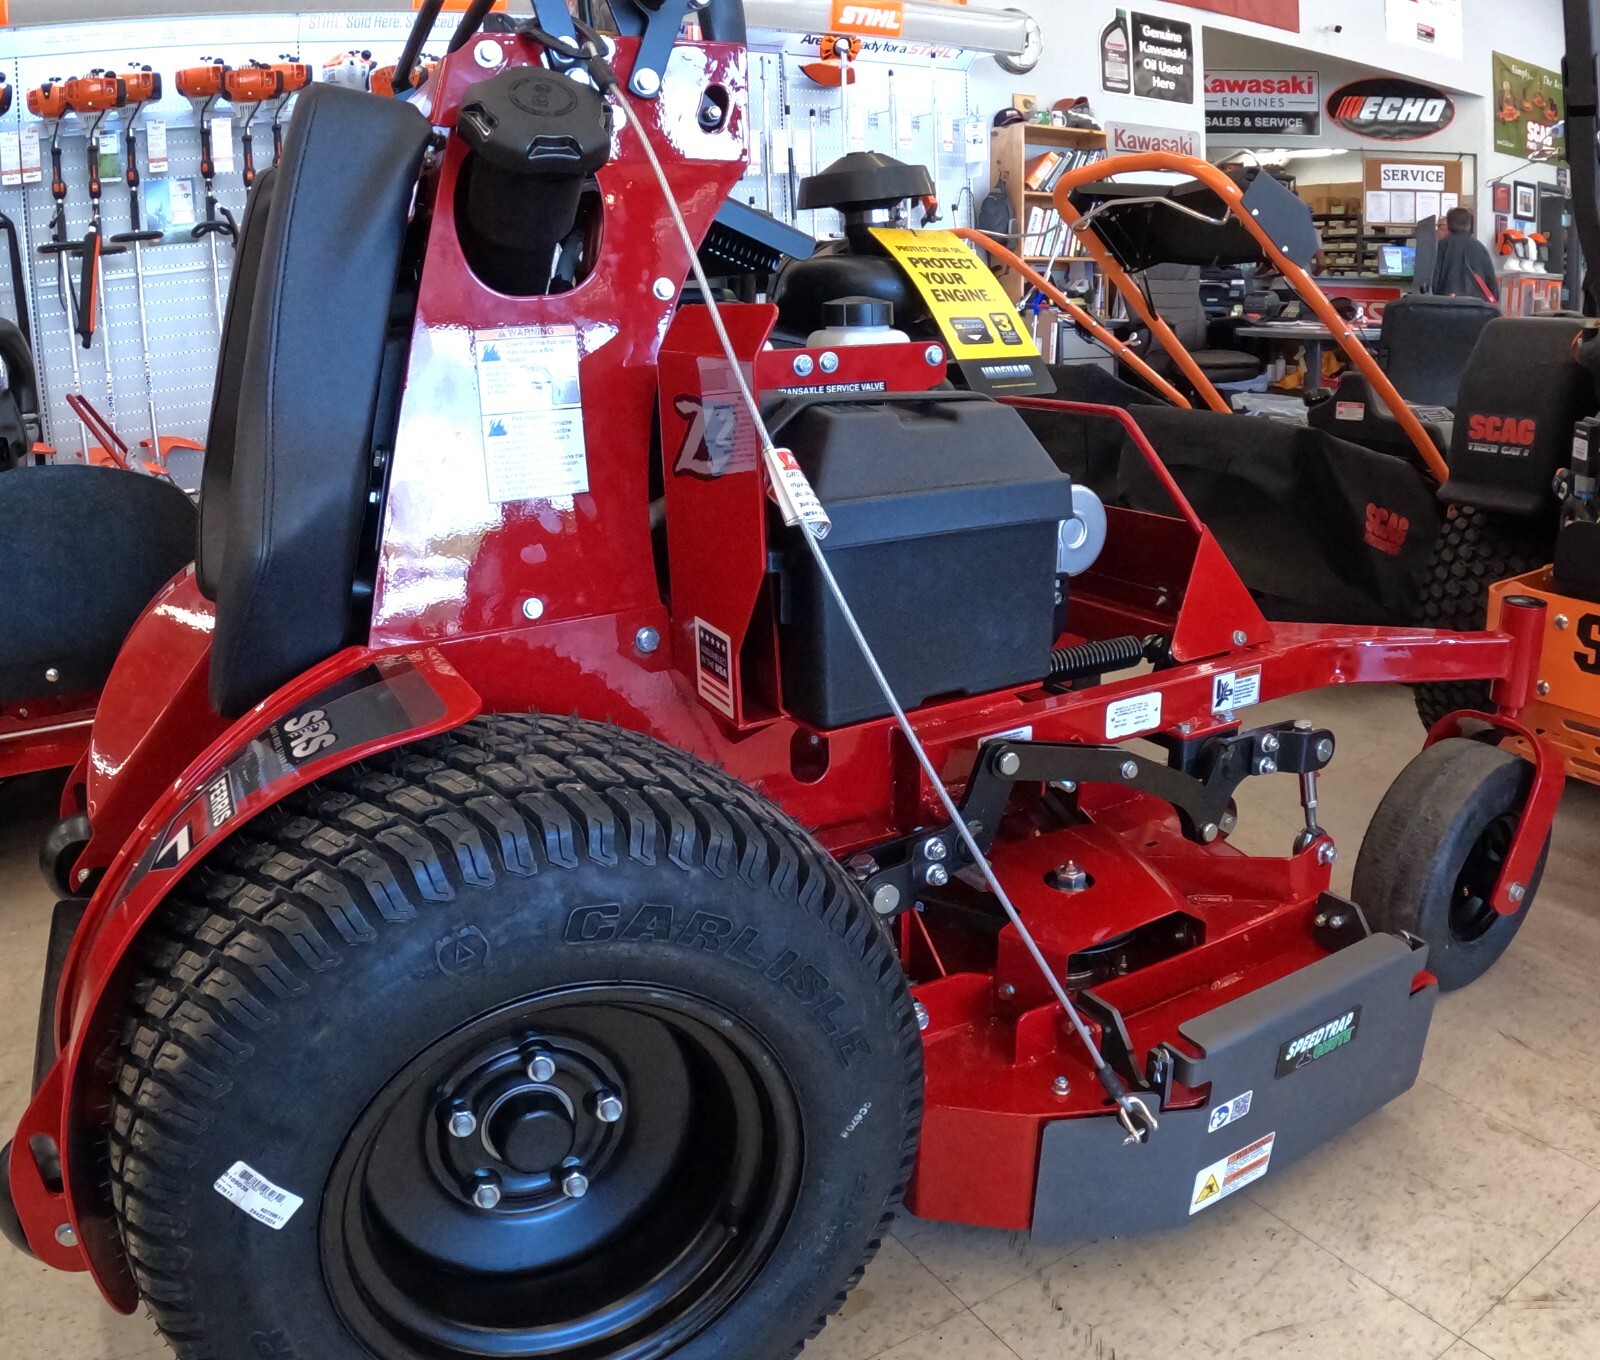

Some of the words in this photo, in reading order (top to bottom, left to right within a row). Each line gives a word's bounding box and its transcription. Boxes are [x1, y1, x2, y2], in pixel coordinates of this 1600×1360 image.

[346, 16, 371, 28] Sold
[374, 16, 403, 28] Here.
[839, 5, 901, 29] STIHL
[1142, 25, 1182, 43] Genuine
[801, 34, 822, 46] Are
[883, 42, 899, 53] for
[899, 46, 907, 54] a
[1139, 40, 1187, 60] Kawasaki
[1143, 58, 1157, 71] Oil
[1158, 60, 1184, 76] Used
[1152, 75, 1176, 90] Here
[1221, 96, 1286, 108] ENGINES
[1359, 96, 1447, 123] ECHO
[1204, 116, 1241, 128] SALES
[1243, 118, 1252, 127] &
[1254, 118, 1304, 128] SERVICE
[1114, 128, 1193, 155] Kawasaki
[1383, 169, 1445, 183] SERVICE
[907, 256, 978, 269] PROTECT
[918, 272, 967, 285] YOUR
[508, 327, 555, 337] WARNING
[991, 315, 1012, 332] 3
[981, 364, 1033, 380] VANGUARD
[826, 383, 860, 393] SERVICE
[861, 381, 885, 391] VALVE
[1469, 414, 1536, 445] SCAG
[284, 710, 336, 758] SRS
[208, 779, 233, 827] FERRIS
[564, 903, 873, 1070] CARLISLE
[1285, 1011, 1355, 1061] SPEEDTRAP
